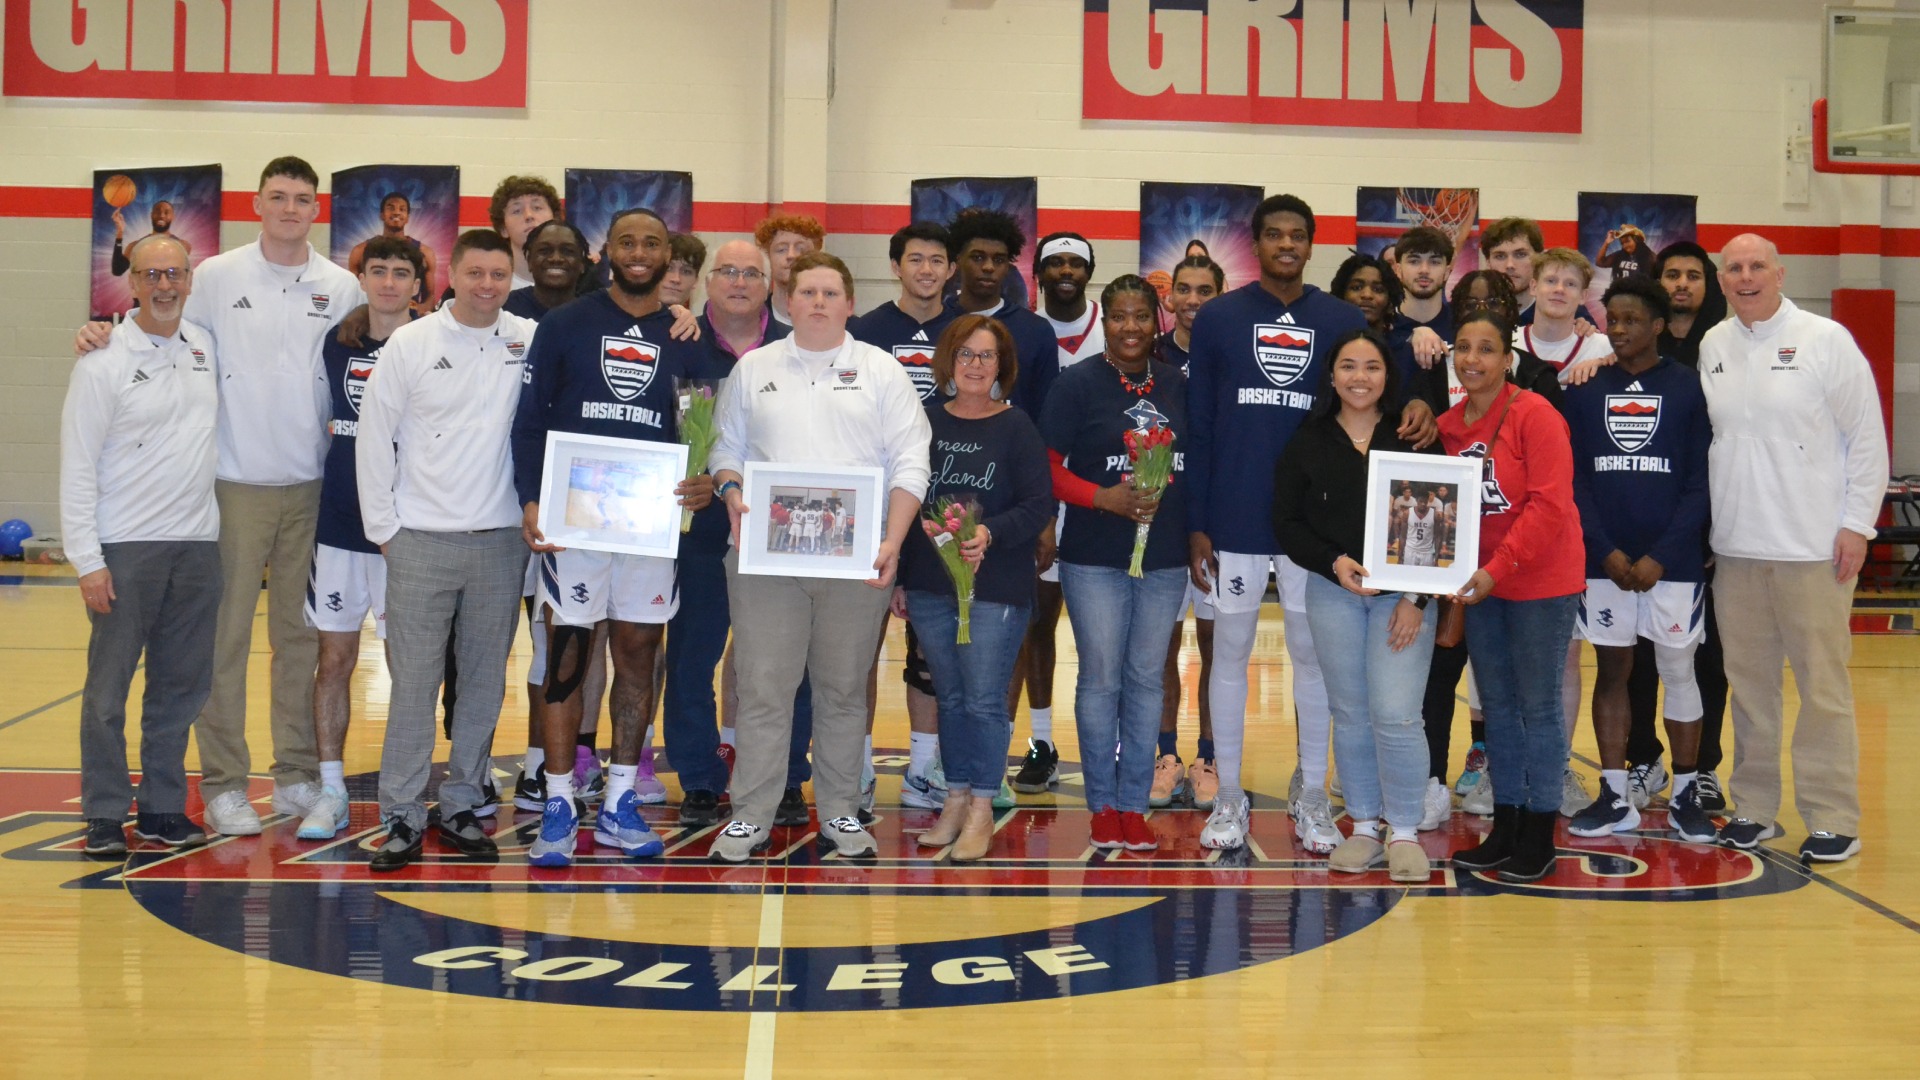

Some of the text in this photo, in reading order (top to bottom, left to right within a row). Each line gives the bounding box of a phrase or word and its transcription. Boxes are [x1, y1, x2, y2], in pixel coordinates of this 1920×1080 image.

[1107, 0, 1563, 108] GRIMS
[1238, 388, 1316, 411] BASKETBAL
[582, 401, 662, 428] BASKETBALL
[937, 440, 983, 453] new
[1594, 456, 1671, 473] BASKETBALL
[1416, 529, 1424, 541] 5
[412, 945, 1111, 991] COLLEGE
